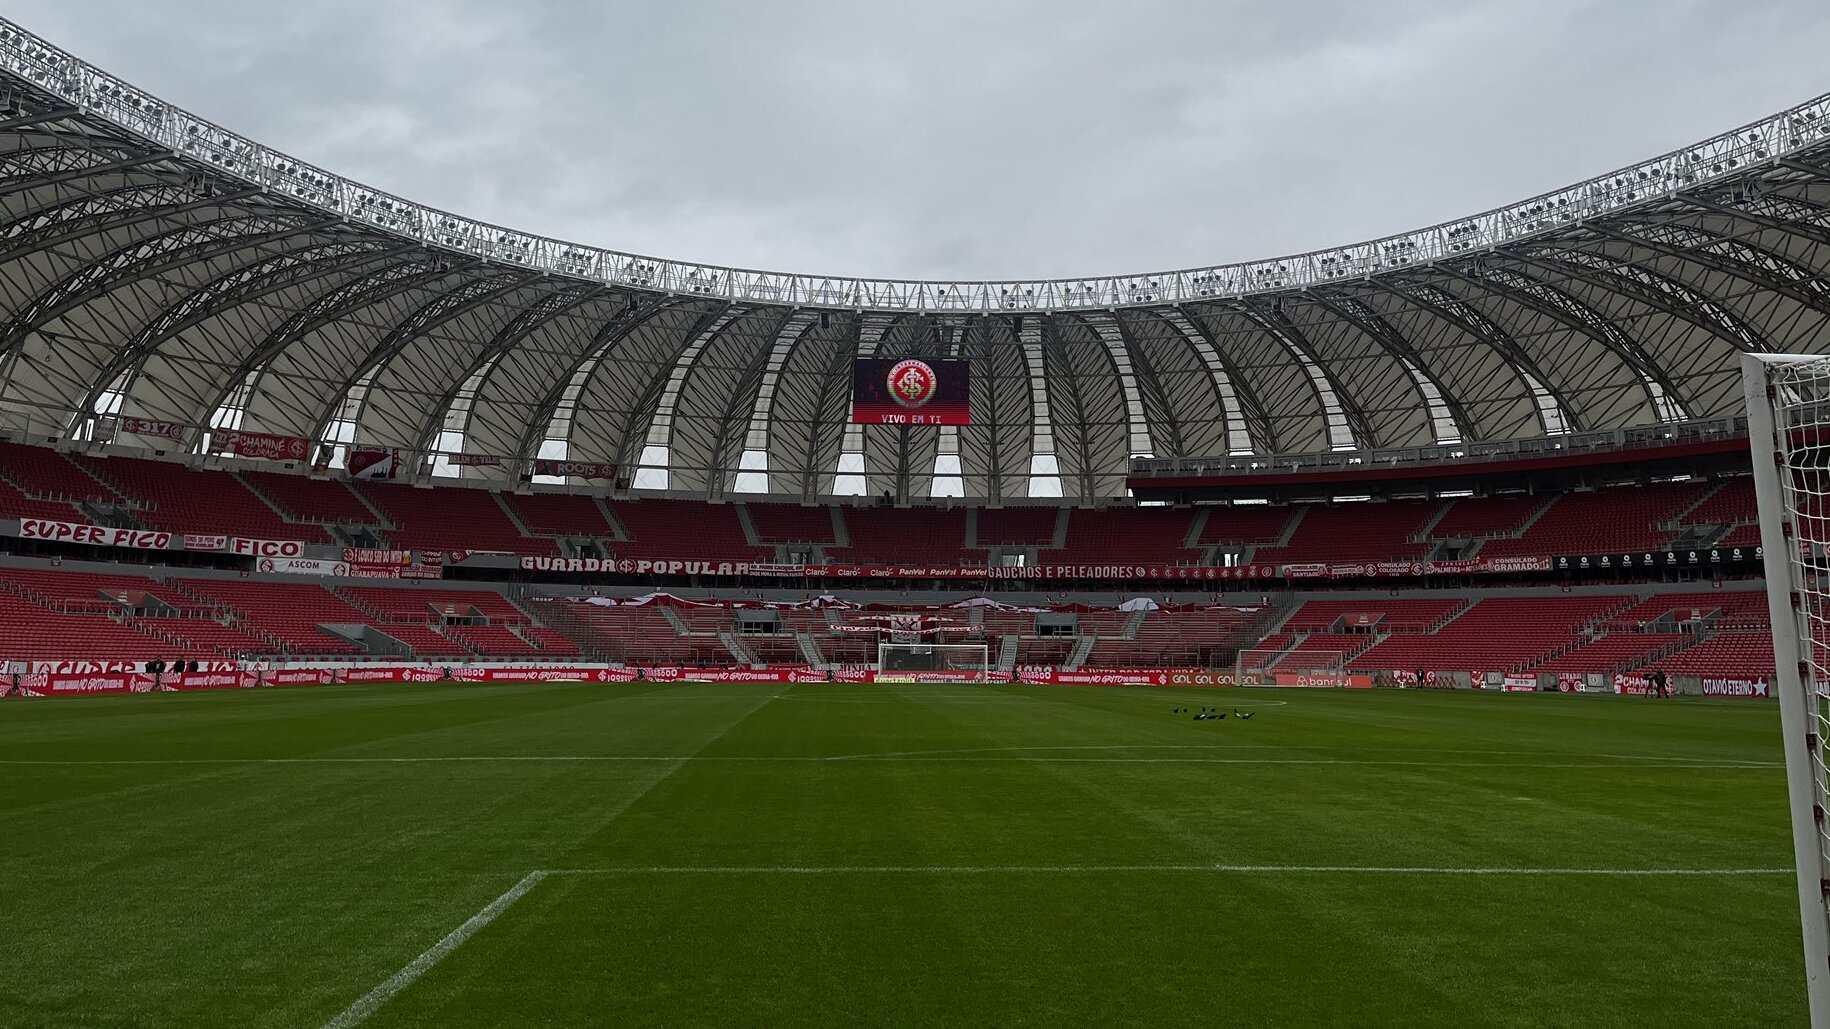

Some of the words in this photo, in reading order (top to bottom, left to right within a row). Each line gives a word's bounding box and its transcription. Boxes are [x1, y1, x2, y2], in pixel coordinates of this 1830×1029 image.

[882, 415, 905, 424] VIVO
[912, 415, 924, 424] EM
[930, 415, 942, 424] TI
[138, 420, 170, 434] 317
[240, 435, 285, 452] CHAMINÉ
[557, 463, 596, 476] ROOTS
[22, 520, 105, 544] SUPER
[113, 529, 169, 548] FICO
[235, 539, 299, 557] FICO
[288, 560, 320, 569] ASCOM
[521, 557, 616, 573] GUARDA
[638, 560, 750, 576] POPULAR
[1494, 562, 1539, 572] GRAMADO
[806, 567, 826, 576] Claro
[838, 567, 858, 576] Claro
[870, 567, 890, 576] Claro
[988, 566, 1041, 578] GAUCHOS
[1046, 566, 1053, 578] E
[1057, 566, 1133, 578] PELEADORES
[525, 671, 538, 680] NO
[538, 671, 560, 680] GRITO
[716, 672, 729, 680] NO
[729, 672, 752, 681] GRITO
[1089, 675, 1101, 684] NO
[1101, 675, 1123, 684] GRITO
[1172, 674, 1191, 684] GOL
[1195, 674, 1214, 684] GOL
[1217, 674, 1236, 684] GOL
[1309, 677, 1352, 687] banrisul
[1728, 679, 1753, 695] ETERNO
